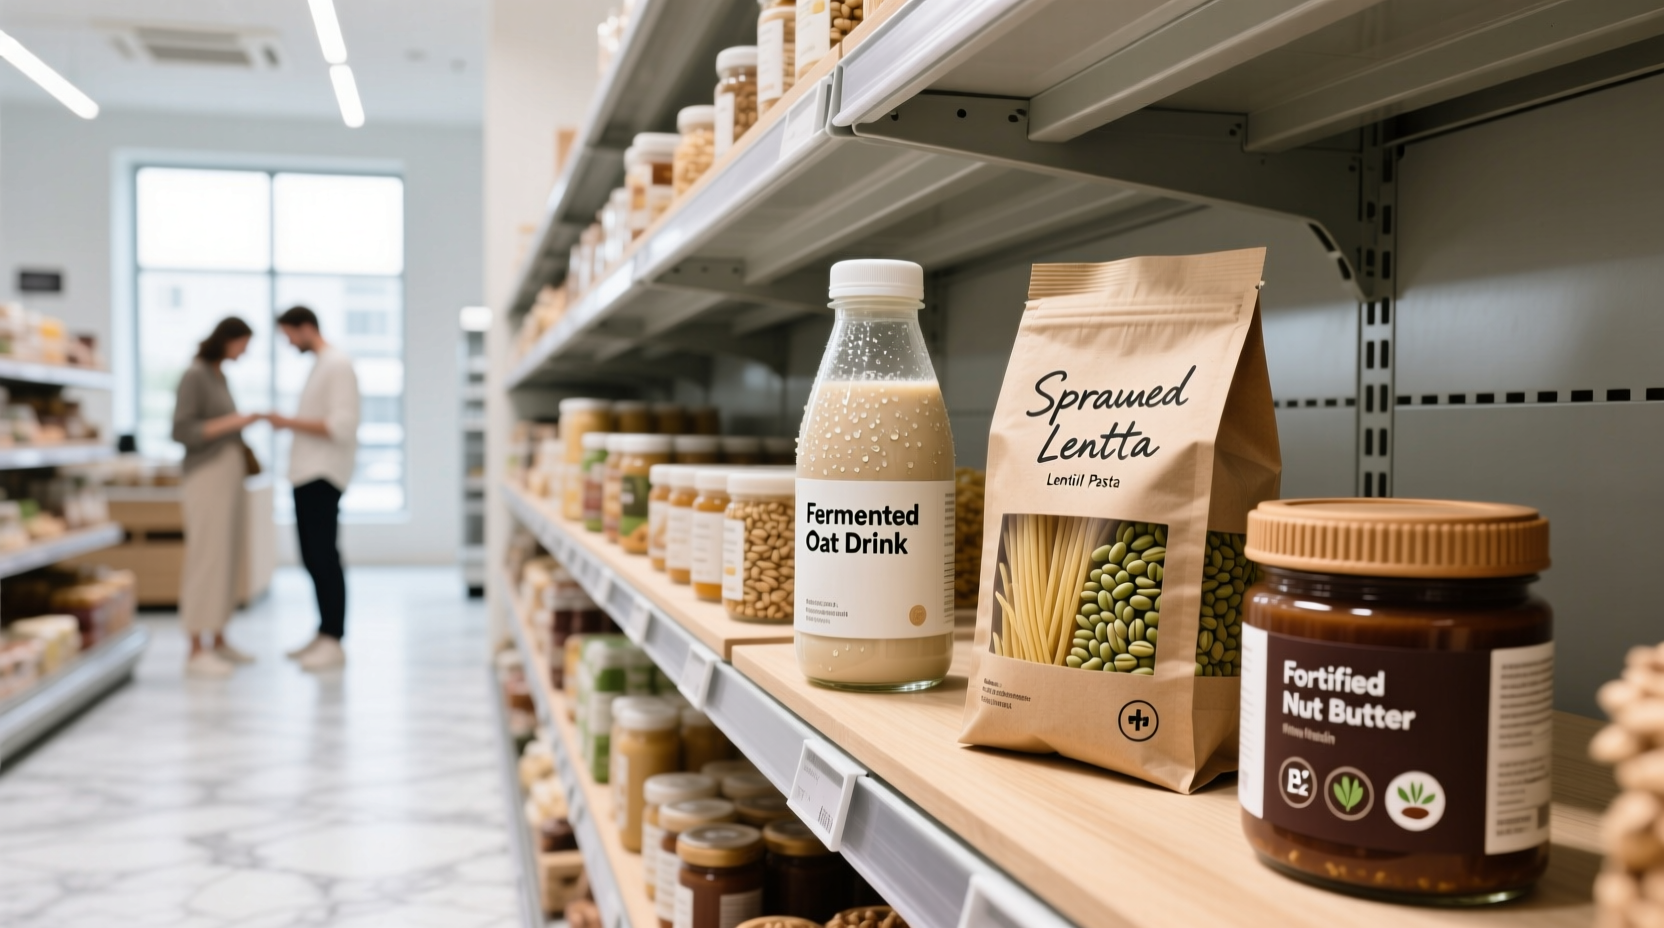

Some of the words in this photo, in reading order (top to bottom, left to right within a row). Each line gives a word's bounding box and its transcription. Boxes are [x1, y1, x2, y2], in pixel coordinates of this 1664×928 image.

[1037, 421, 1160, 463] Lentta
[1088, 474, 1121, 488] Pasta
[806, 502, 919, 526] Fermented
[805, 529, 839, 553] Oat
[845, 531, 908, 555] Drink
[1283, 660, 1386, 697] Fortified
[1282, 690, 1323, 721] Nut
[1328, 697, 1416, 731] Butter
